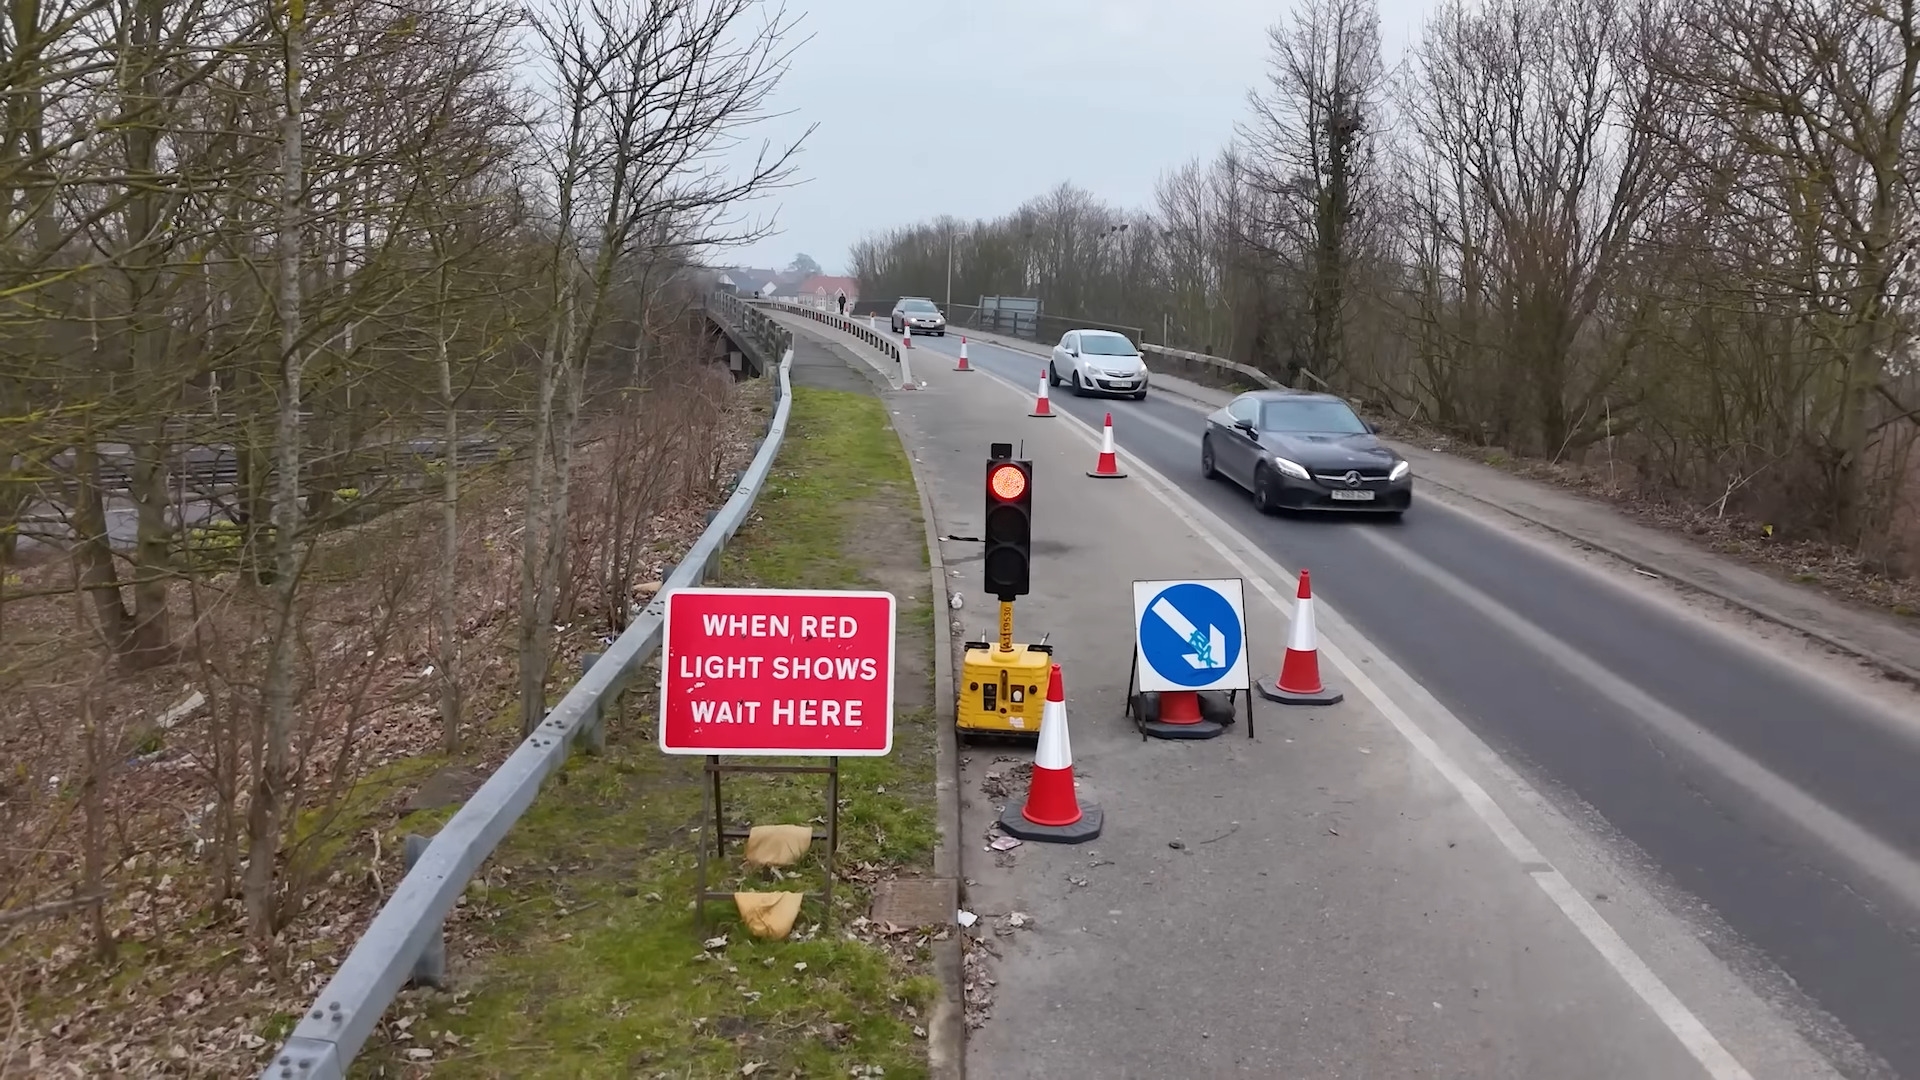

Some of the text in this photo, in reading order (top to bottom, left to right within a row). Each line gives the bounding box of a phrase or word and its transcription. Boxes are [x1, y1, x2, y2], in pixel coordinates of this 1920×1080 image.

[702, 614, 859, 639] WHEN RED
[680, 655, 878, 682] LIGHT SHOWS
[690, 699, 863, 727] WAIT HERE
